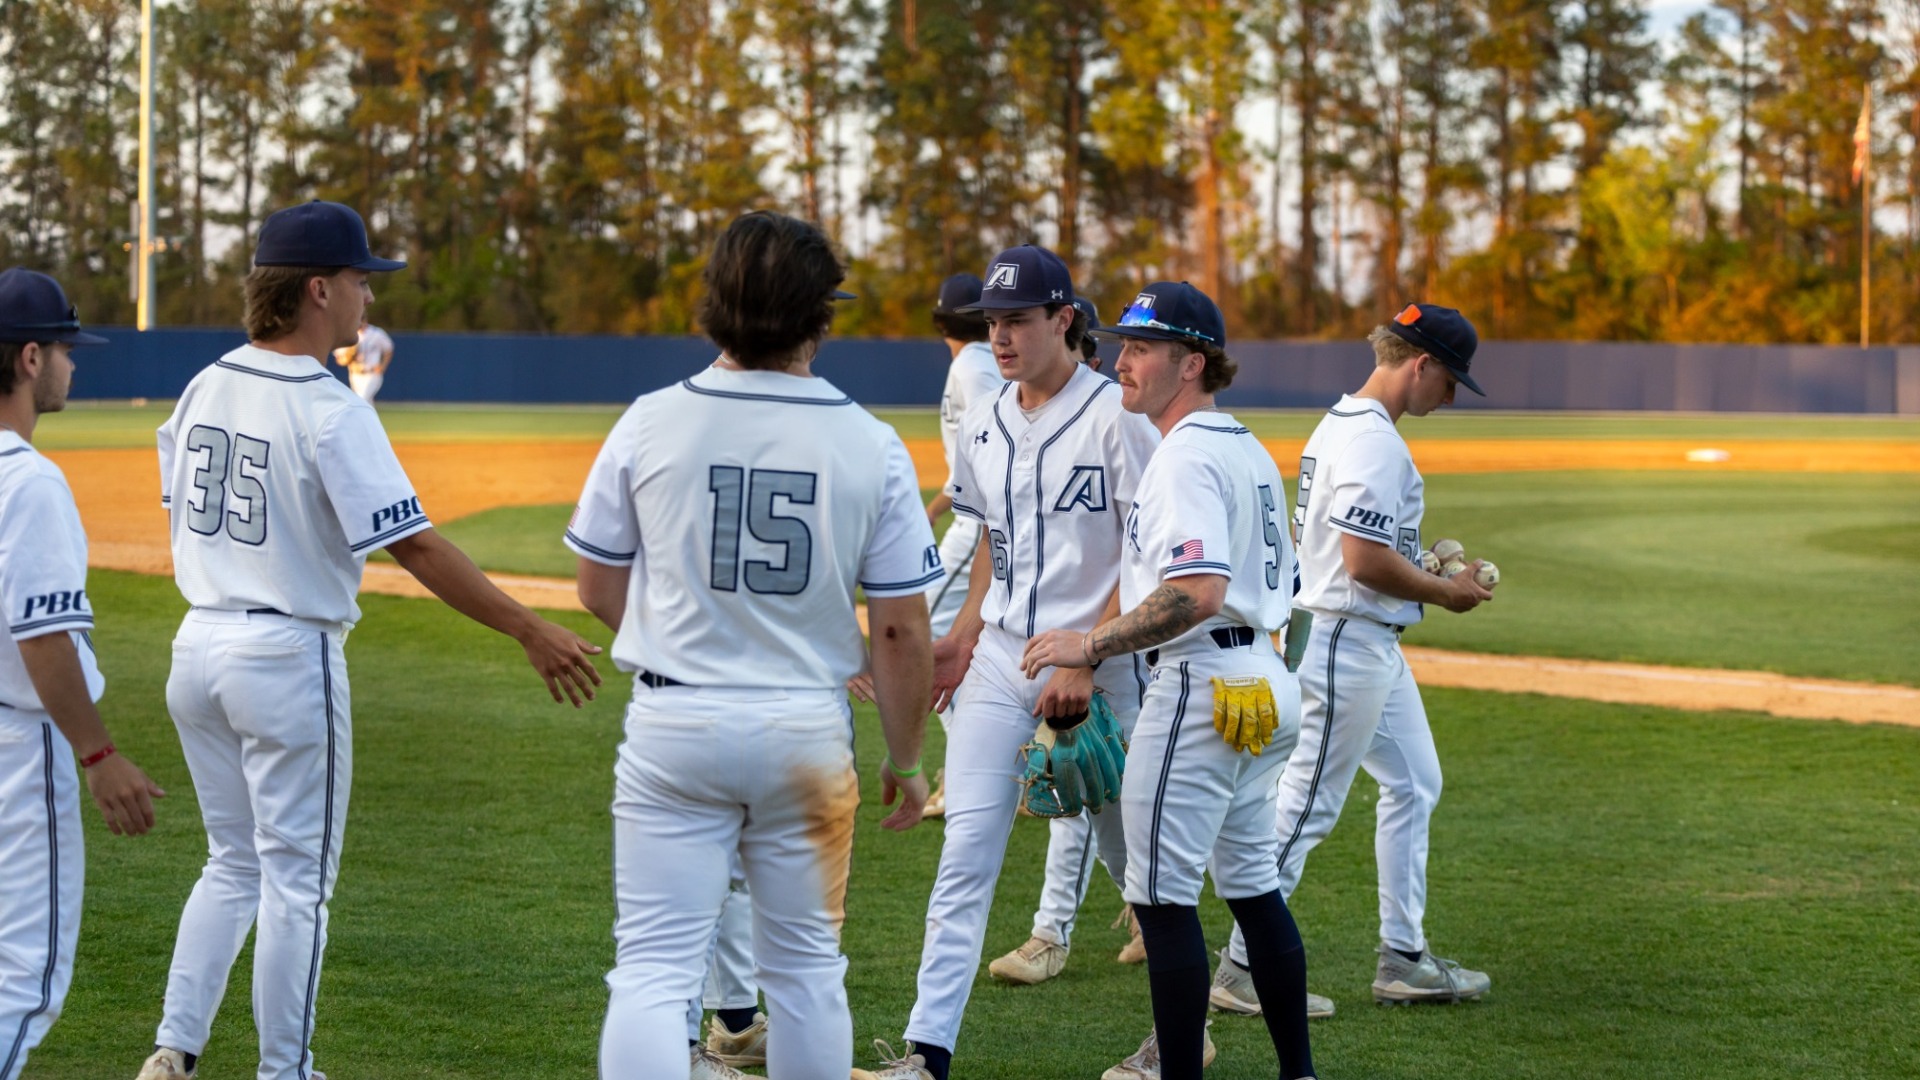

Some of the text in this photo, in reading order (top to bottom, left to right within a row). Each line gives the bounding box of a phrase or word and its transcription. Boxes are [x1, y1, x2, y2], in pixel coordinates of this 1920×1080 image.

[983, 263, 1020, 291] A
[187, 424, 270, 546] 35
[1053, 465, 1107, 512] A
[372, 496, 423, 533] PBC
[709, 465, 817, 595] 15
[1345, 506, 1393, 532] PBC
[1258, 485, 1282, 590] 5
[23, 590, 89, 619] PBC
